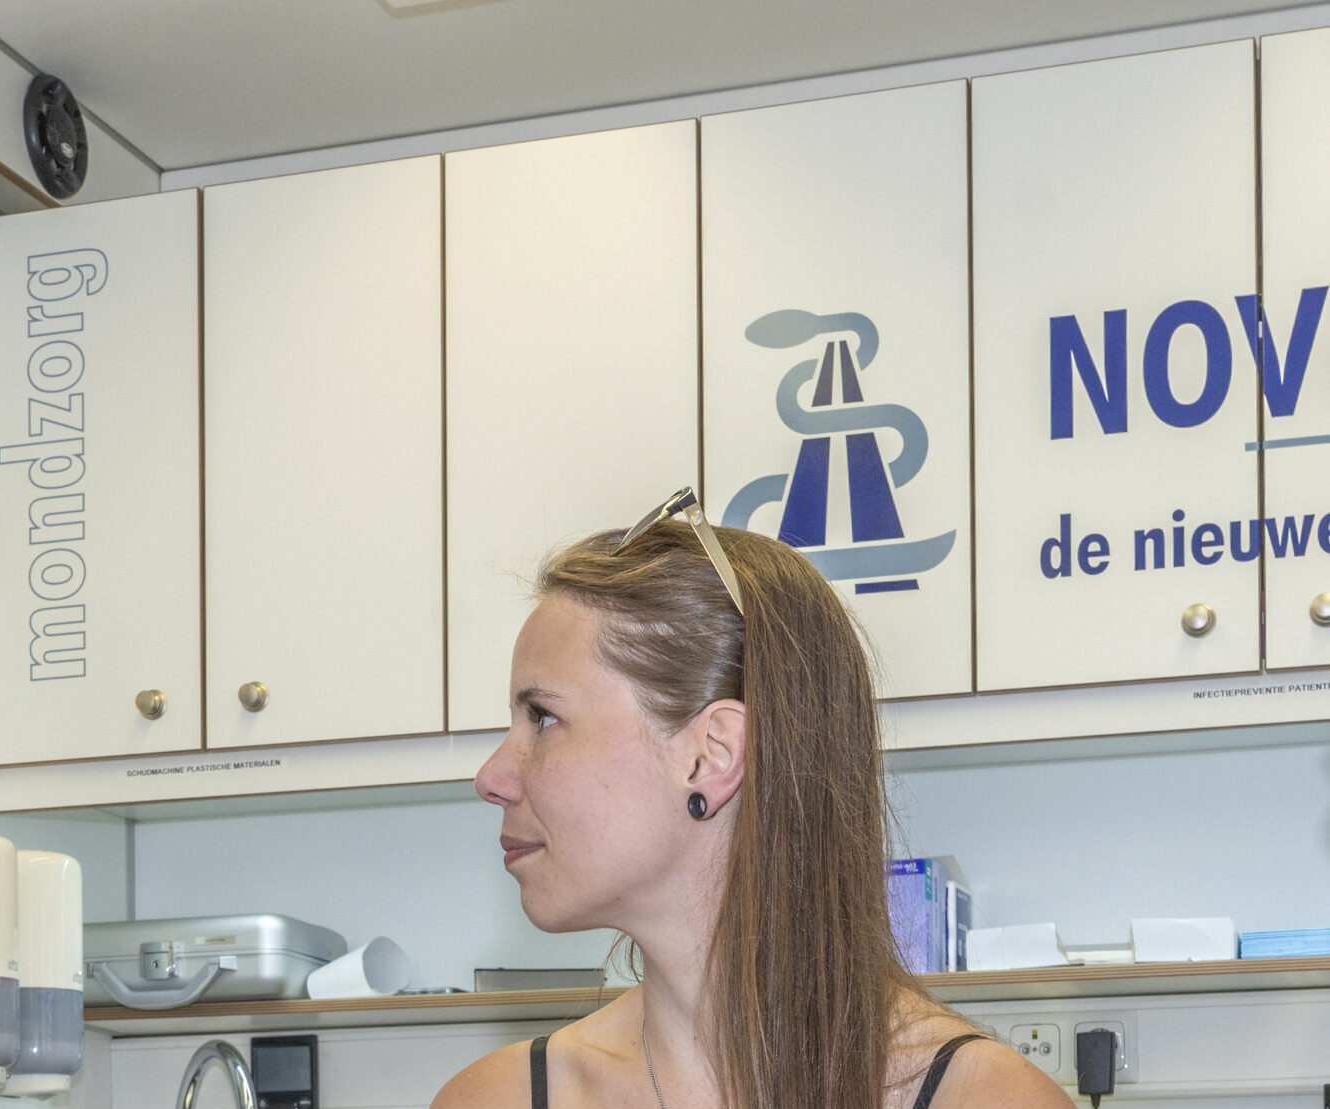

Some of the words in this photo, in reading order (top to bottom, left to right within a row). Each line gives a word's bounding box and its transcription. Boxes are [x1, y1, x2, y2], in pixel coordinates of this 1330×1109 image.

[1049, 286, 1330, 440] NOV
[1040, 513, 1110, 579] de
[1193, 685, 1285, 699] INFECTIEPREVENTIE
[1289, 682, 1330, 693] PATIENT
[126, 766, 184, 777] SCHUDMACHINE
[186, 762, 231, 773] PLASTISCHE
[233, 759, 281, 769] MATERIALEN
